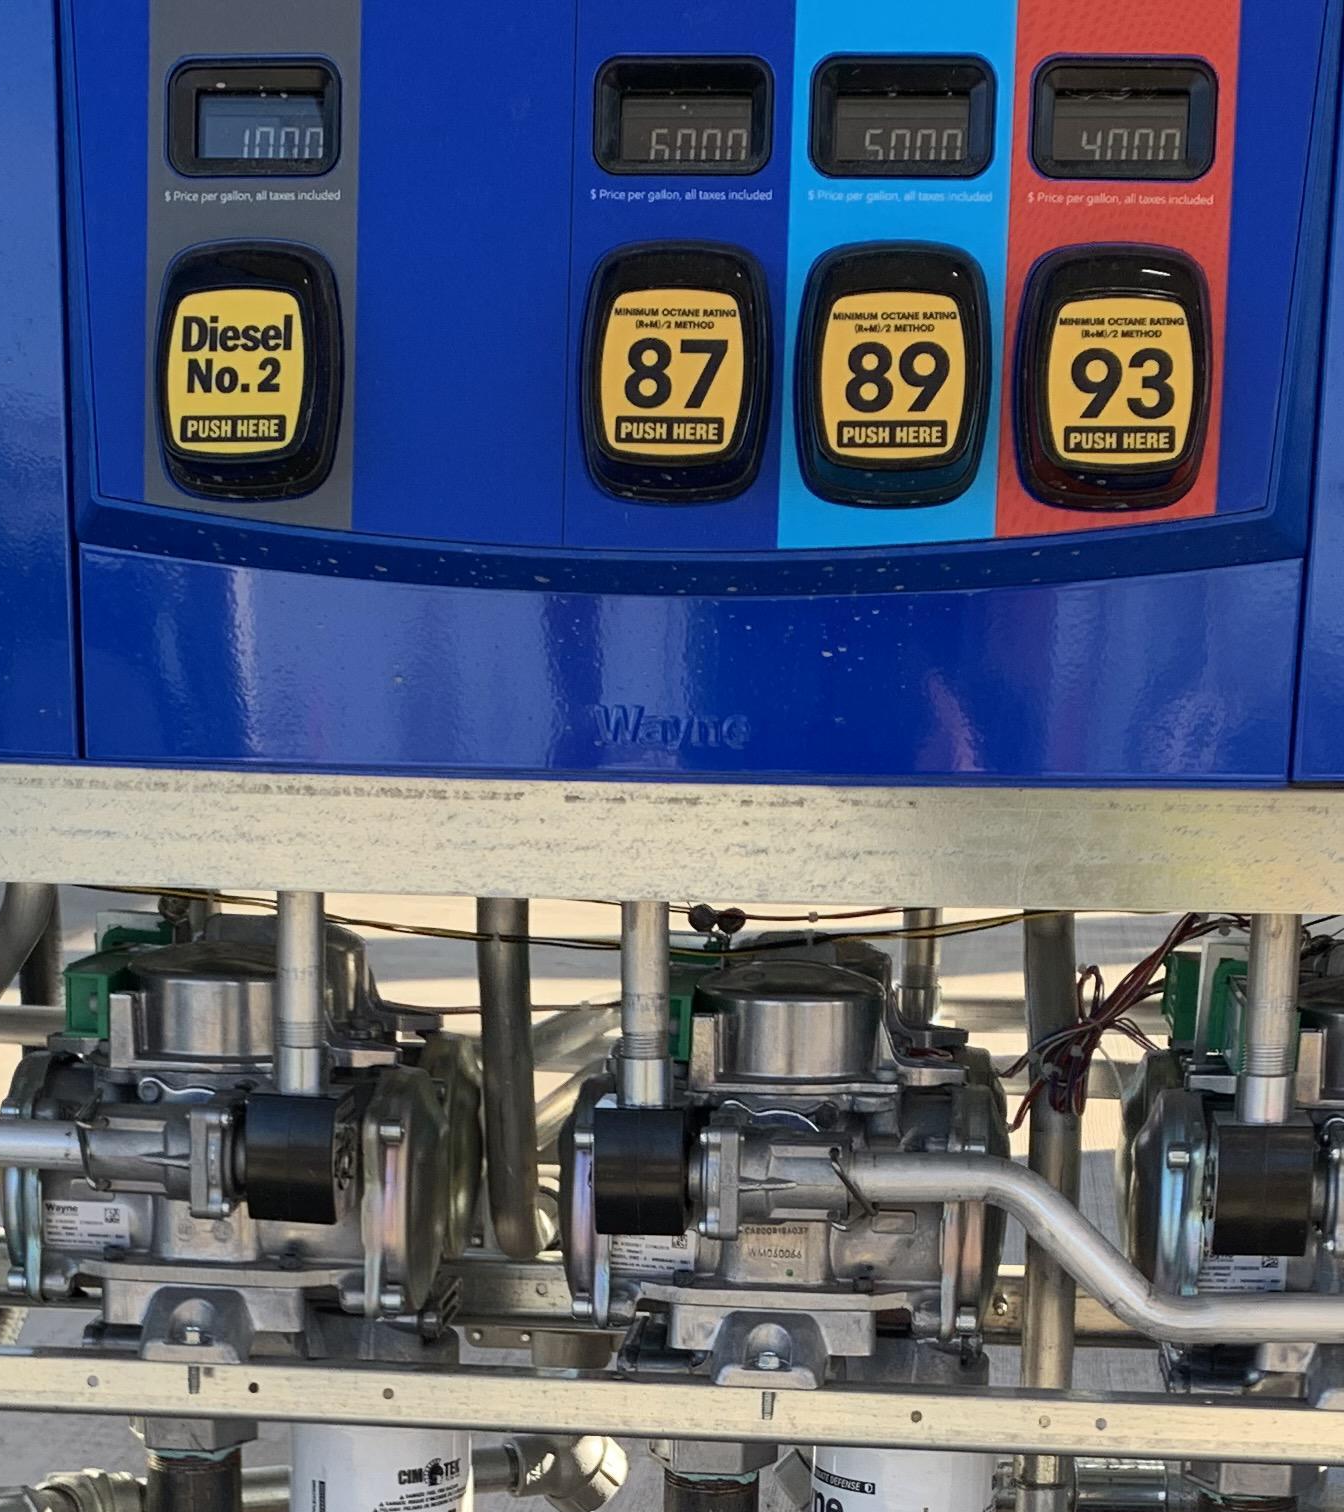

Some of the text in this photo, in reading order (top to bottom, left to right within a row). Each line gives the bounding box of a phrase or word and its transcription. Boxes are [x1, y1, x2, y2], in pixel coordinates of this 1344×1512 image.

[164, 190, 171, 201] $
[173, 190, 198, 200] Price
[201, 192, 217, 202] per
[256, 190, 267, 200] all
[269, 190, 295, 200] taxes
[298, 190, 341, 201] included
[590, 189, 597, 200] $
[599, 189, 626, 199] Price
[628, 191, 645, 201] per
[685, 189, 696, 199] all
[699, 189, 726, 199] taxes
[729, 189, 773, 200] included
[808, 191, 814, 202] $
[817, 191, 843, 201] Price
[846, 193, 863, 203] per
[904, 191, 915, 201] all
[918, 191, 945, 201] taxes
[948, 191, 992, 202] included
[1027, 192, 1034, 202] $
[1037, 192, 1063, 202] Price
[1066, 195, 1083, 205] per
[1124, 194, 1136, 203] all
[1139, 195, 1166, 205] taxes
[1168, 194, 1214, 205] included
[614, 308, 737, 318] MINIMUM OCTANE RATING
[833, 312, 957, 320] MINIMUM OCTANE RATING
[674, 320, 715, 329] METHOD
[894, 324, 935, 332] METHOD
[1059, 317, 1184, 326] MINIMUM OCTANE RATING
[181, 314, 293, 352] Diesel
[1121, 330, 1162, 338] METHOD
[187, 357, 281, 394] No. 2
[624, 337, 728, 409] 87
[845, 341, 950, 413] 89
[1071, 347, 1175, 419] 93
[187, 419, 280, 438] PUSH HERE
[620, 422, 718, 440] PUSH HERE
[843, 426, 942, 443] PUSH HERE
[1069, 432, 1170, 449] PUSH HERE
[592, 704, 752, 754] Wayne
[45, 1202, 78, 1213] Wayne
[398, 1468, 423, 1485] CIM
[830, 1475, 861, 1491] DEFENSE
